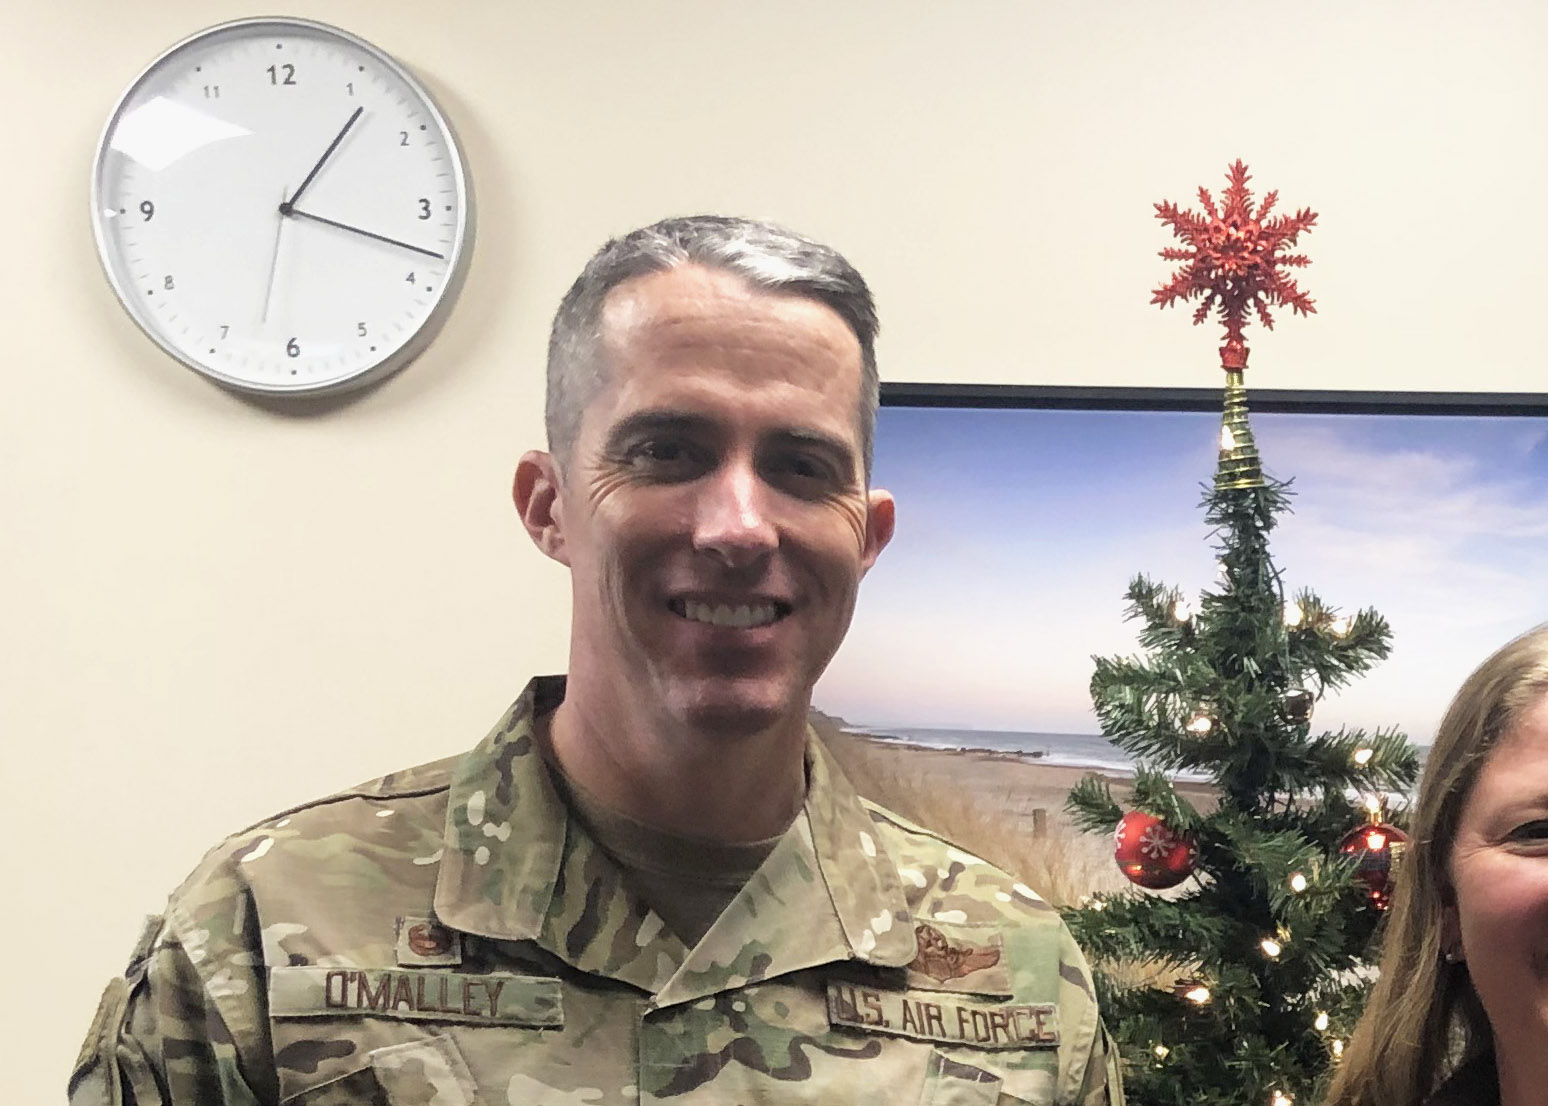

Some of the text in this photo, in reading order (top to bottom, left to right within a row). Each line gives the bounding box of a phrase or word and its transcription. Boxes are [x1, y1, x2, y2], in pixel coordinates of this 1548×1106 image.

[266, 63, 297, 86] 12
[203, 85, 220, 99] 11
[346, 83, 354, 96] 1
[400, 131, 410, 147] 2
[140, 200, 154, 222] 9
[418, 198, 431, 220] 3
[164, 275, 175, 290] 8
[405, 271, 416, 285] 4
[220, 325, 230, 340] 7
[357, 322, 367, 337] 5
[286, 337, 300, 358] 6
[325, 970, 505, 1017] O'MALLEY
[902, 998, 946, 1038] AIR
[956, 1005, 1056, 1043] FORCE
